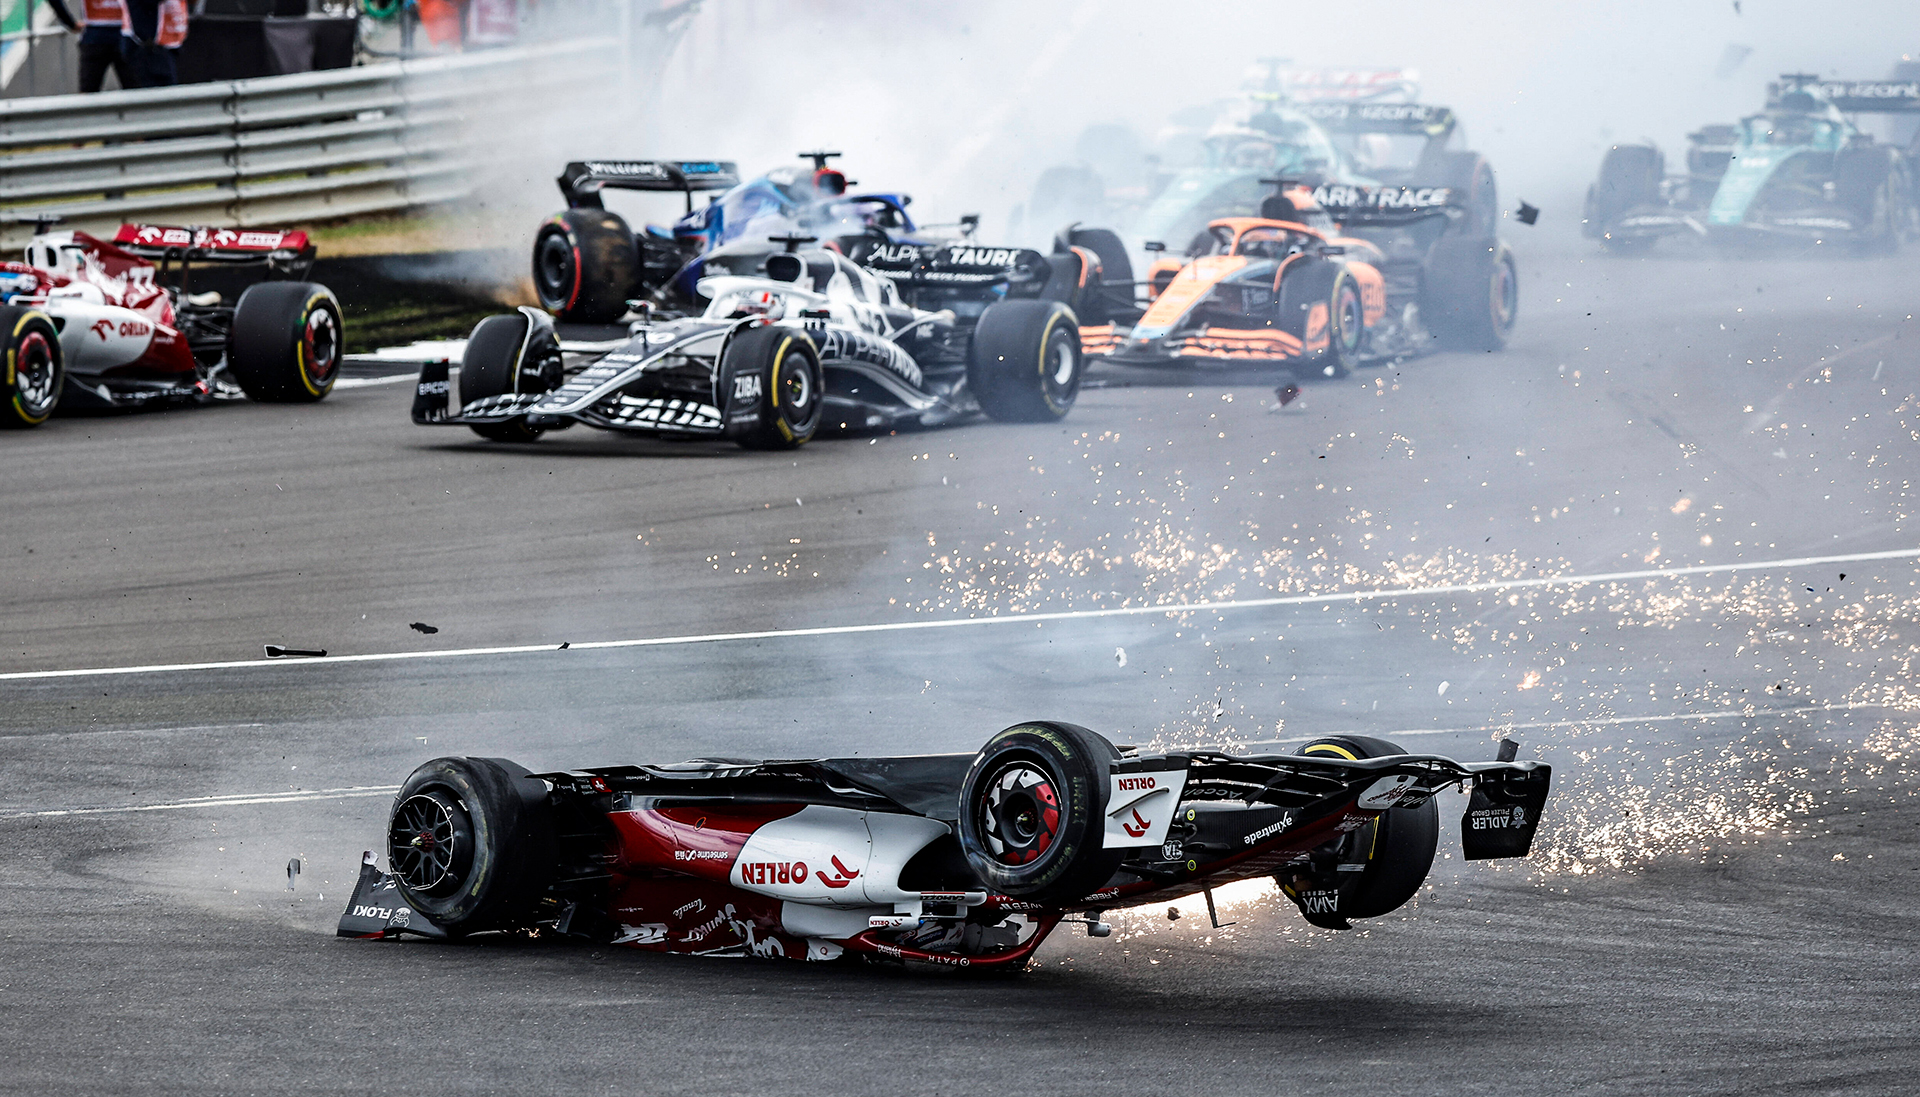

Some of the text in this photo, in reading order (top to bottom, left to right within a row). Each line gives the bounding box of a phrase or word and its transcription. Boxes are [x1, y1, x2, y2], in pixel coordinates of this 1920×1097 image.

[119, 322, 150, 337] ORLEN
[1118, 777, 1156, 791] ORLEN
[1243, 811, 1293, 846] aximtrade
[1471, 816, 1510, 830] ADLER
[697, 850, 729, 860] sensetime
[741, 861, 808, 885] ORLEN
[671, 897, 707, 920] Tonale
[1302, 895, 1339, 914] AMX
[352, 905, 393, 919] FLOKI
[870, 919, 890, 927] ORLEN
[928, 954, 958, 965] PATH
